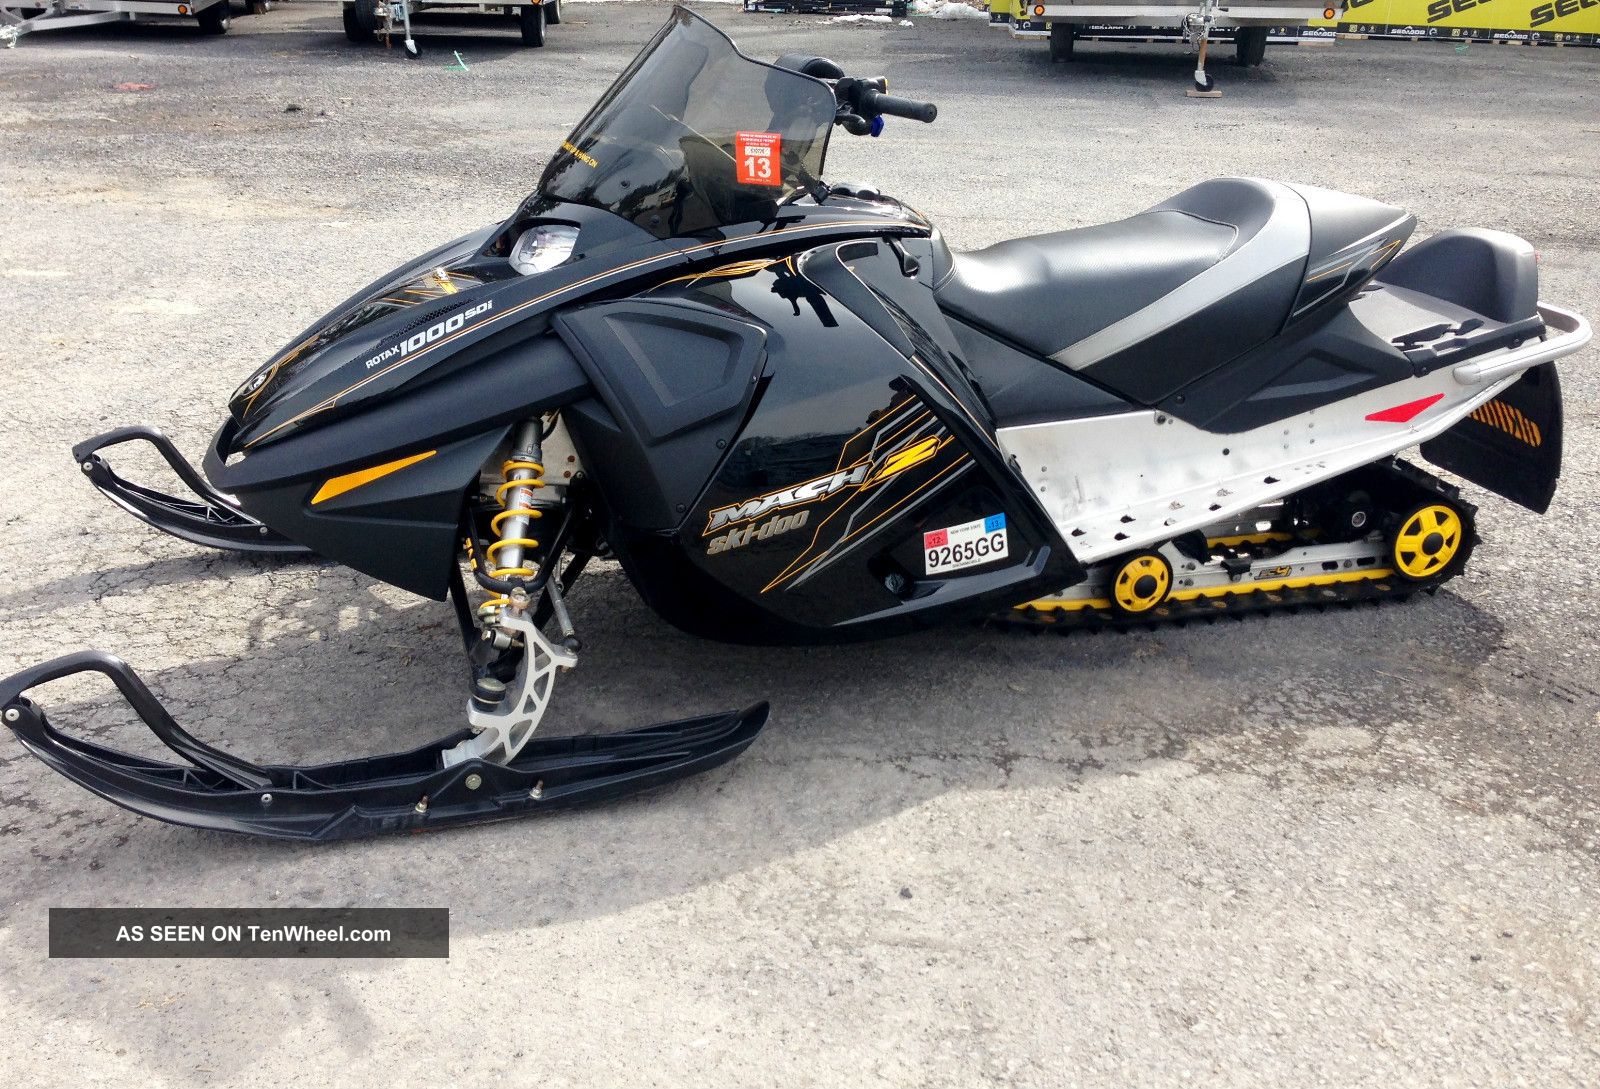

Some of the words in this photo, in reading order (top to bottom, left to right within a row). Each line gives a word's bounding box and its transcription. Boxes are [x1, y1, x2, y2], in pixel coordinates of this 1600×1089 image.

[744, 156, 772, 178] 13
[365, 345, 400, 369] ROTAX
[400, 312, 465, 357] 1000
[709, 463, 870, 529] MACH
[928, 532, 1005, 568] 9265GG
